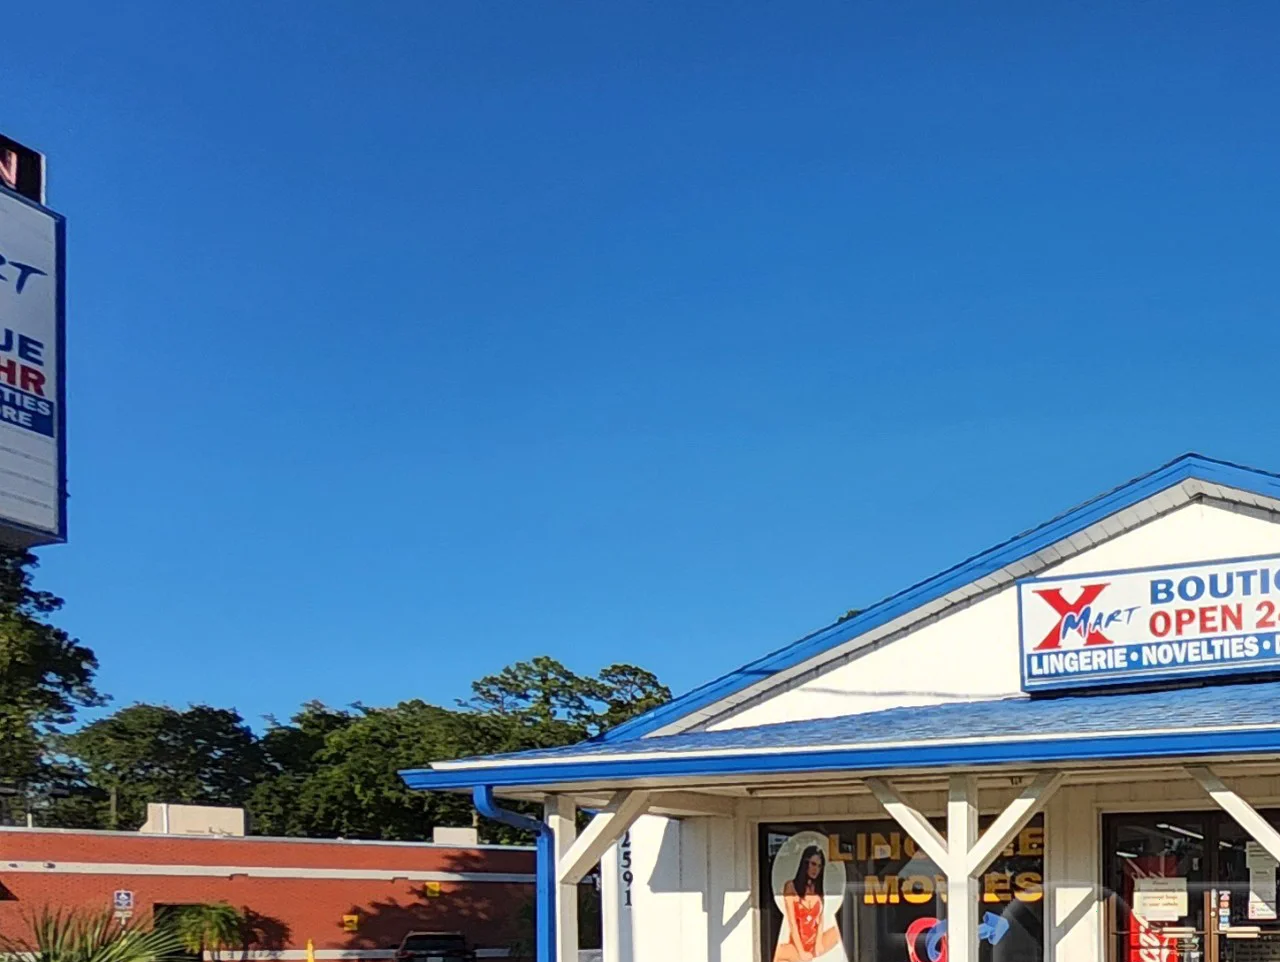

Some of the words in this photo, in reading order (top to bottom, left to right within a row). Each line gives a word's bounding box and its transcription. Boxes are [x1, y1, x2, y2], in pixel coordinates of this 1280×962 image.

[1032, 583, 1114, 650] X
[1150, 603, 1243, 638] OPEN
[1031, 646, 1128, 675] LINGERIE
[1142, 635, 1259, 666] NOVELTIES
[829, 827, 1044, 862] LINE
[621, 830, 633, 906] 2591
[864, 873, 1043, 904] MOES
